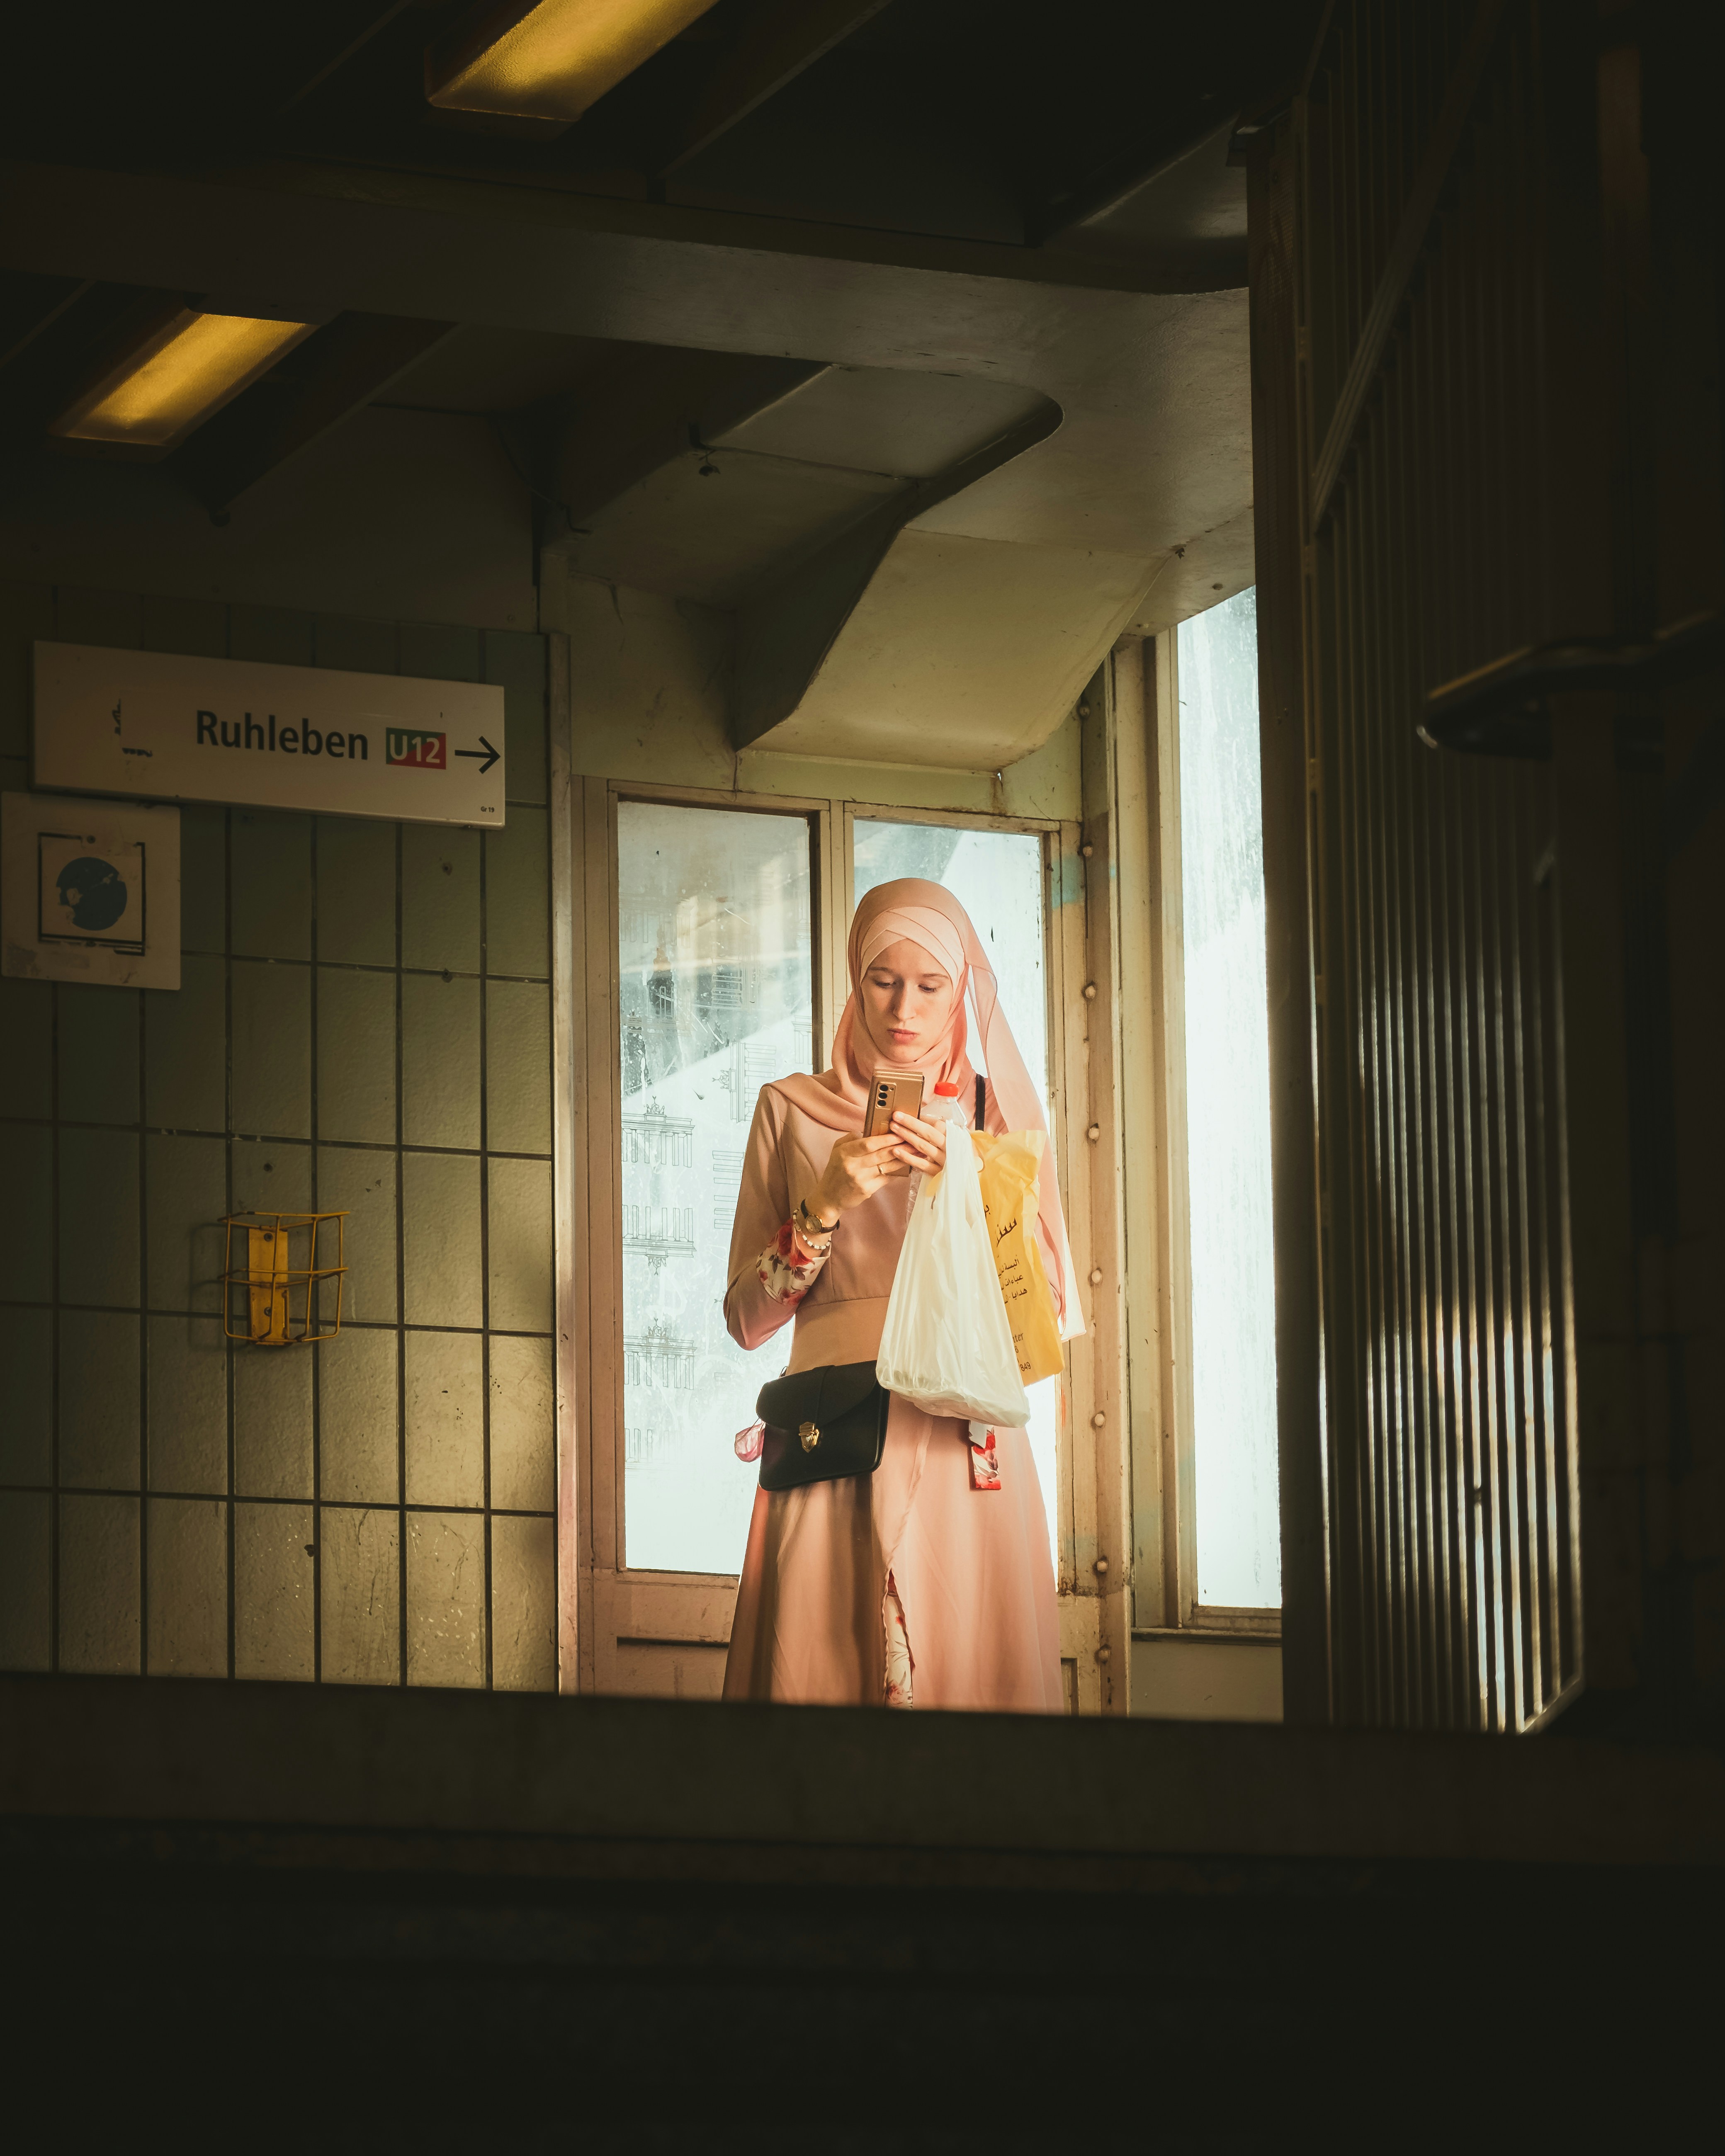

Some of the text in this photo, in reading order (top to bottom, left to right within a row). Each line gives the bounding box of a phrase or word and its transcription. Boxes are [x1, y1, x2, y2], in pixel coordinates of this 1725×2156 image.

[197, 709, 441, 764] Ruhleben U12
[1020, 1361, 1031, 1372] 849
